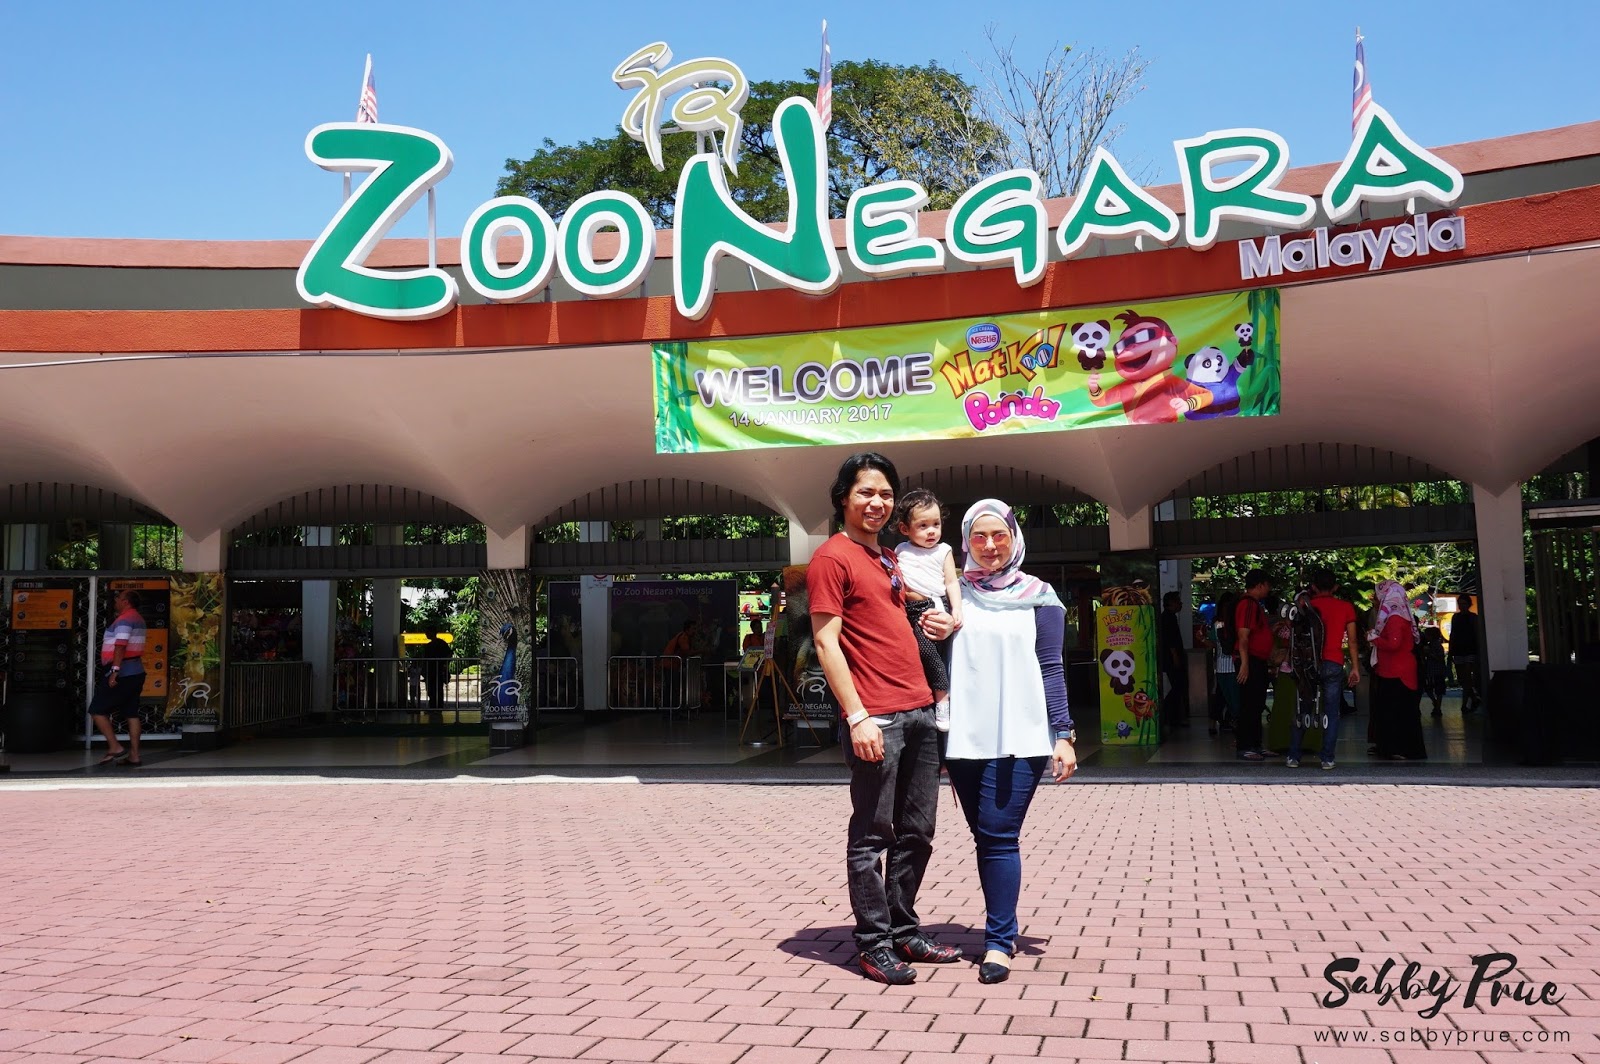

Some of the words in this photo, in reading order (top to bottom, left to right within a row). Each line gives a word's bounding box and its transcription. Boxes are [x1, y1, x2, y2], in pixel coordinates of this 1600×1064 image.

[673, 95, 1465, 321] NEGARA
[1238, 213, 1466, 280] Malaysia
[693, 353, 936, 408] WELCOME
[729, 411, 750, 427] 14
[753, 407, 844, 426] JANUARY
[848, 403, 893, 422] 2017
[964, 385, 1061, 432] Panda
[612, 587, 622, 596] To
[624, 587, 641, 596] Zoo
[642, 587, 673, 597] Negara
[675, 587, 713, 596] Malaysia
[187, 707, 216, 715] NEGARA
[485, 705, 500, 713] ZOO
